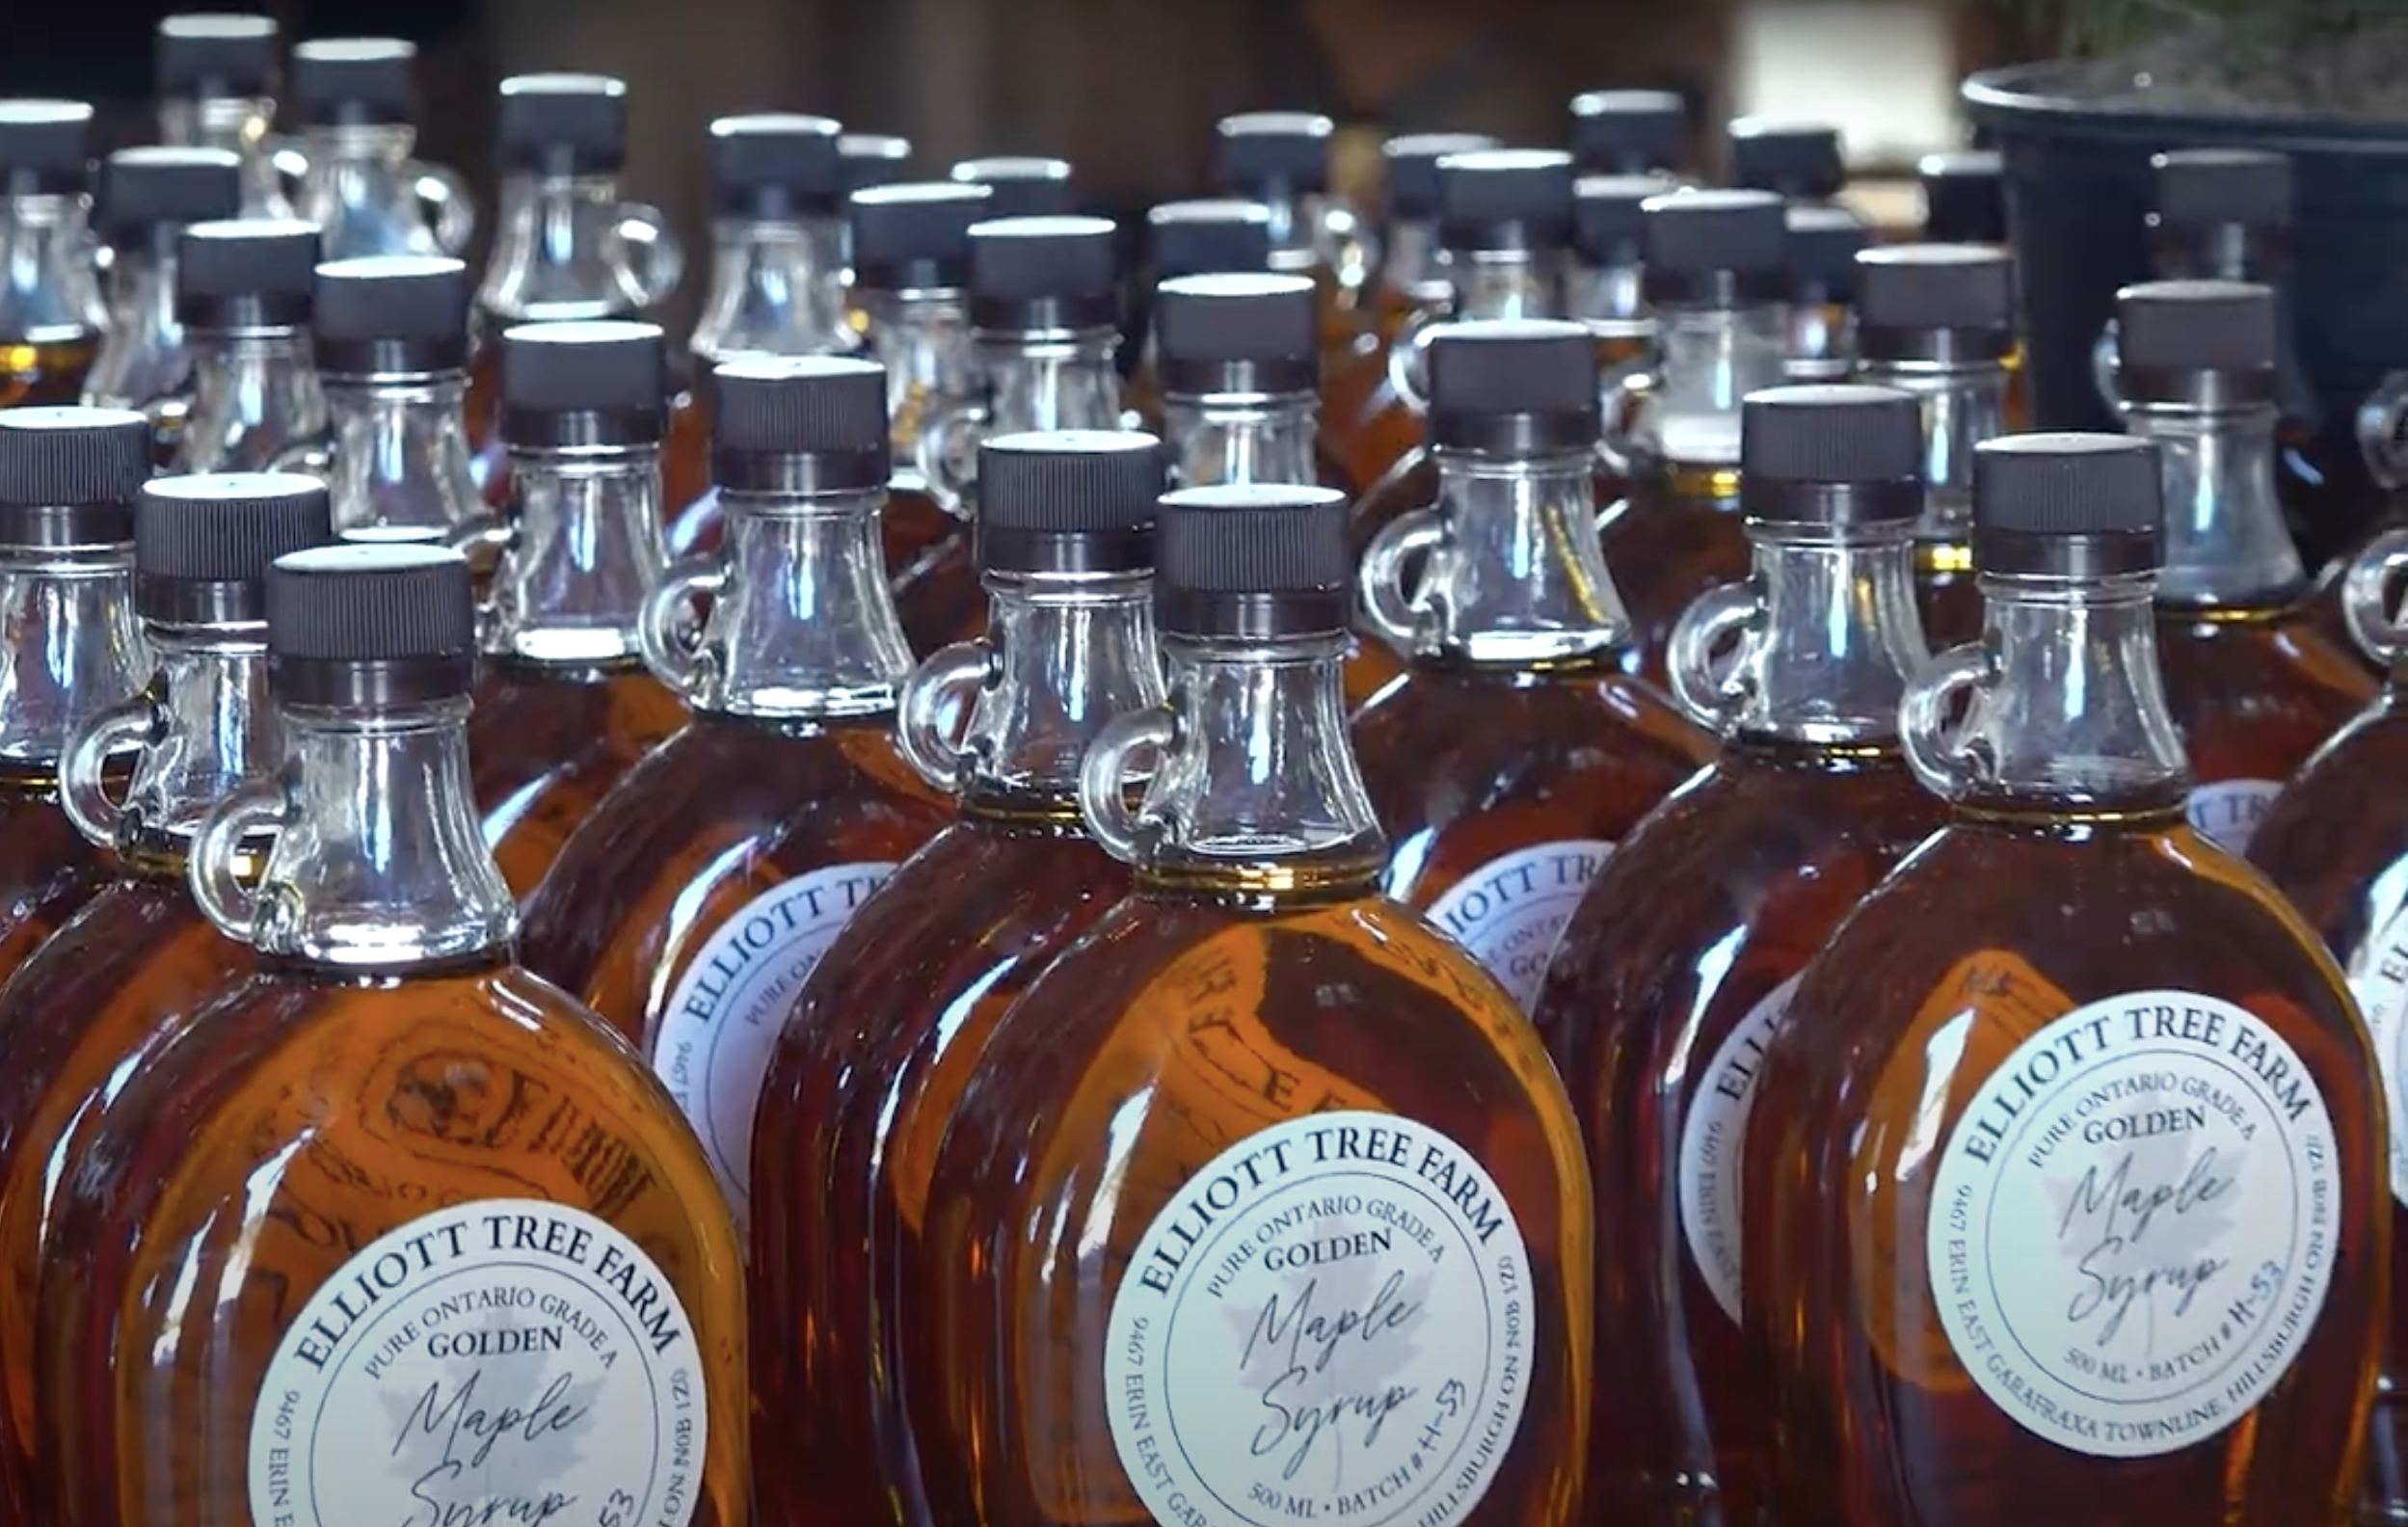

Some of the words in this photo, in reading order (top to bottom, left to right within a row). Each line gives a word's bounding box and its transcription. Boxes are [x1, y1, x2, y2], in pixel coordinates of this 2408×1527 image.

[1445, 861, 1538, 935] IOTT
[682, 884, 825, 1025] ELLIOTT
[1963, 1015, 2112, 1168] ELLIOTT
[2125, 1005, 2225, 1048] TREE
[2228, 1026, 2314, 1124] FARM
[2027, 1110, 2076, 1169] PURE
[2075, 1071, 2179, 1117] ONTARIO
[2181, 1074, 2248, 1129] GRADE
[2240, 1125, 2259, 1142] A
[2083, 1105, 2207, 1145] GOLDEN
[1139, 1139, 1292, 1299] ELLIOTT
[1305, 1125, 1413, 1166] TREE
[1415, 1143, 1505, 1246] FARM
[1949, 1184, 1973, 1233] 9467
[2057, 1146, 2235, 1244] Maple
[1207, 1238, 1257, 1299] PURE
[1257, 1194, 1362, 1242] ONTARIO
[1366, 1197, 1434, 1251] GRADE
[1428, 1244, 1445, 1265] A
[1264, 1227, 1393, 1272] GOLDEN
[1948, 1239, 1970, 1294] ERIN
[294, 1220, 470, 1373] ELLIOTT
[482, 1214, 593, 1264] TREE
[592, 1245, 681, 1356] FARM
[1240, 1269, 1423, 1373] Maple
[2067, 1236, 2230, 1348] Syrup
[363, 1319, 422, 1380] PURE
[422, 1286, 536, 1329] ONTARIO
[539, 1293, 606, 1352] GRADE
[599, 1350, 618, 1371] A
[427, 1325, 564, 1359] GOLDEN
[1125, 1315, 1150, 1367] 9467
[1957, 1299, 1994, 1353] EAST
[1499, 1354, 1520, 1396] ON
[2062, 1348, 2097, 1375] 500
[2100, 1362, 2130, 1383] ML
[2148, 1334, 2221, 1381] BATCH
[273, 1388, 301, 1440] 9467
[390, 1368, 588, 1467] Maple
[1125, 1373, 1151, 1432] ERIN
[1250, 1365, 1420, 1482] Syrup
[268, 1447, 290, 1508] ERIN
[1136, 1434, 1176, 1490] EAST
[1246, 1482, 1283, 1511] 500
[1284, 1494, 1318, 1518] ML
[1337, 1464, 1412, 1516] BATCH
[663, 1473, 685, 1516] ON
